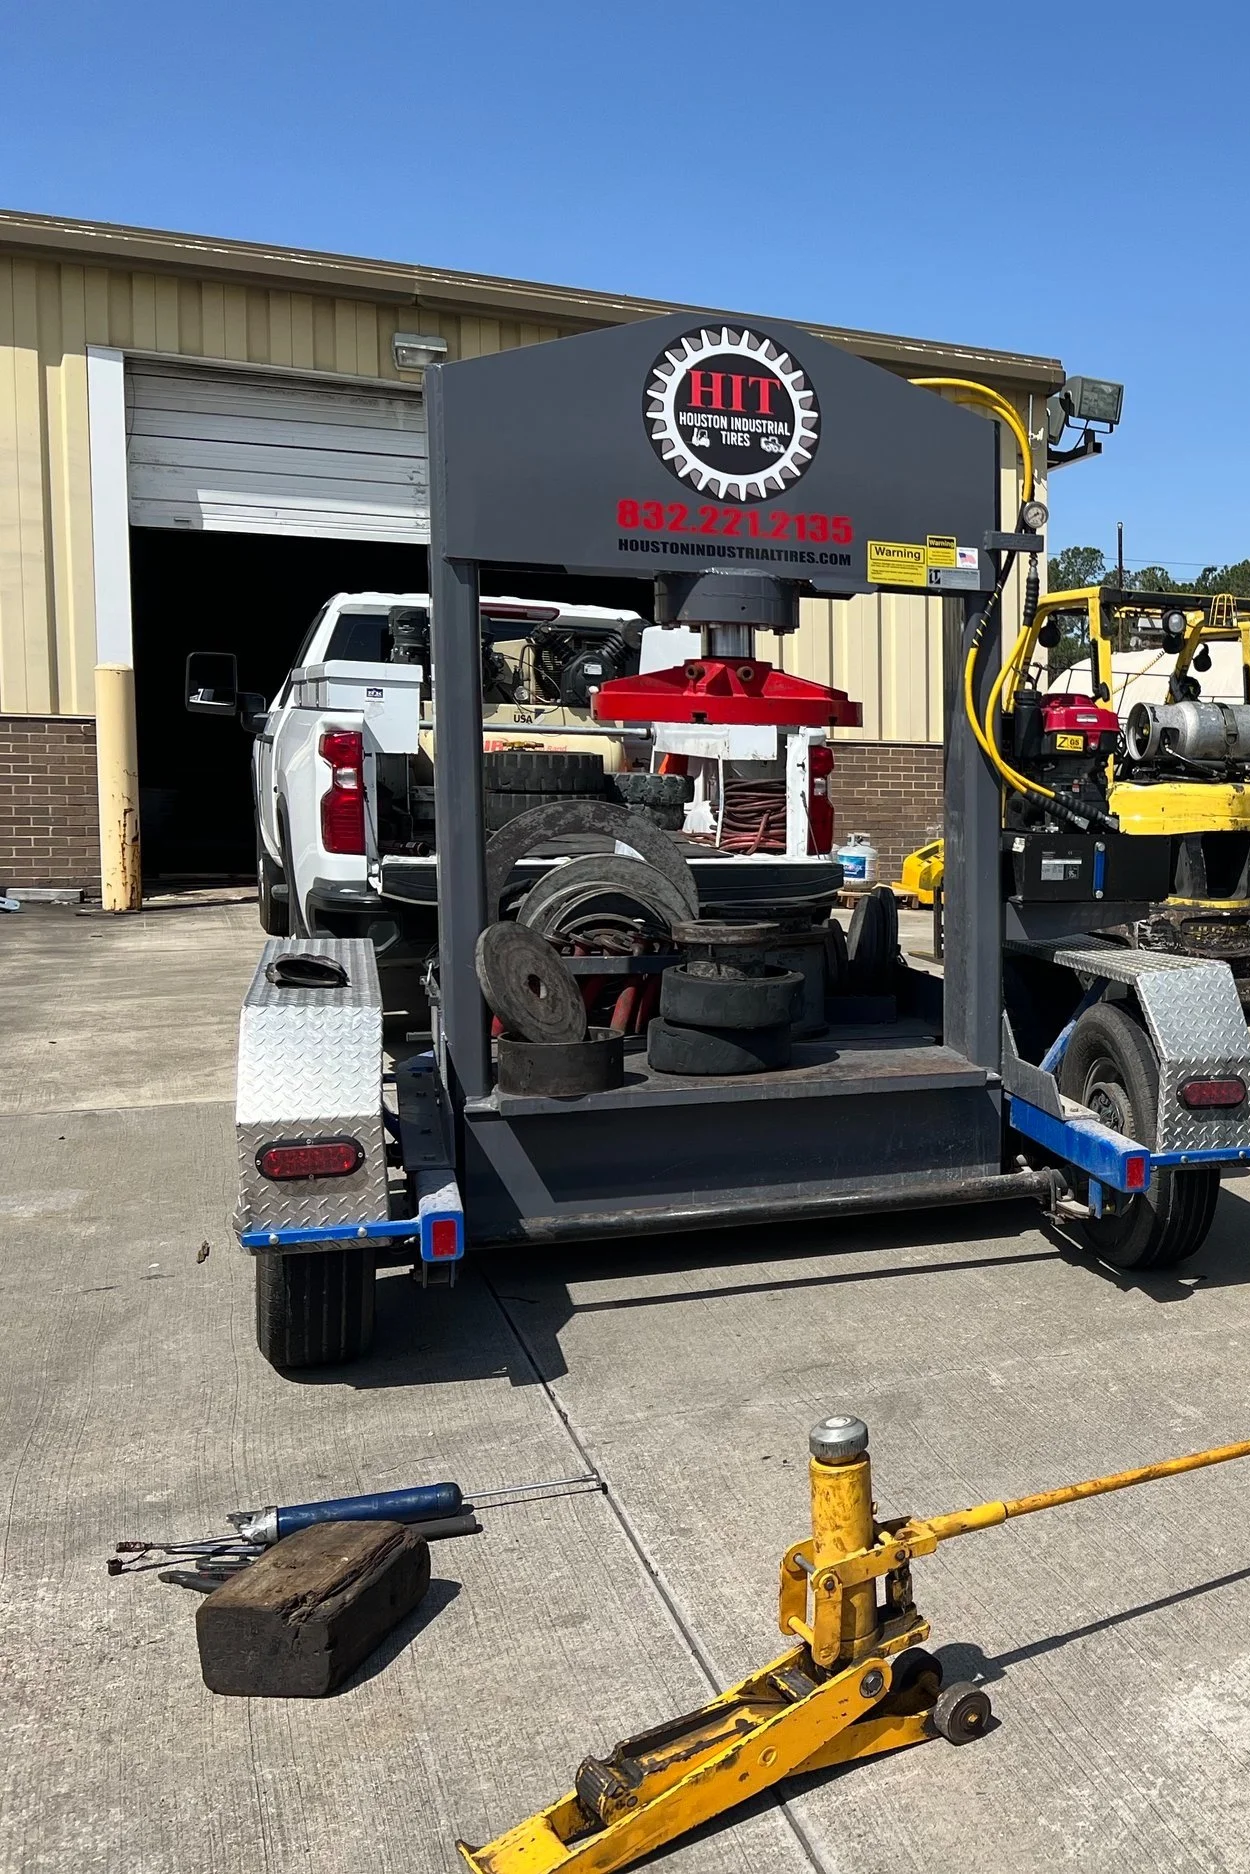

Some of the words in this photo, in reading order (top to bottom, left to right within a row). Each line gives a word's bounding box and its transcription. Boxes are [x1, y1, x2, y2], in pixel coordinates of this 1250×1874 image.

[686, 369, 781, 415] HIT
[679, 411, 728, 430] HOUSTON
[730, 416, 791, 437] INDUSTRIAL
[720, 430, 751, 447] TIRES
[616, 498, 853, 545] 832.221.2135
[618, 538, 851, 566] HOUSTONINDUSTRIALTIRES.COM
[874, 546, 921, 561] Warning
[929, 539, 955, 549] Warning
[513, 714, 533, 724] USA
